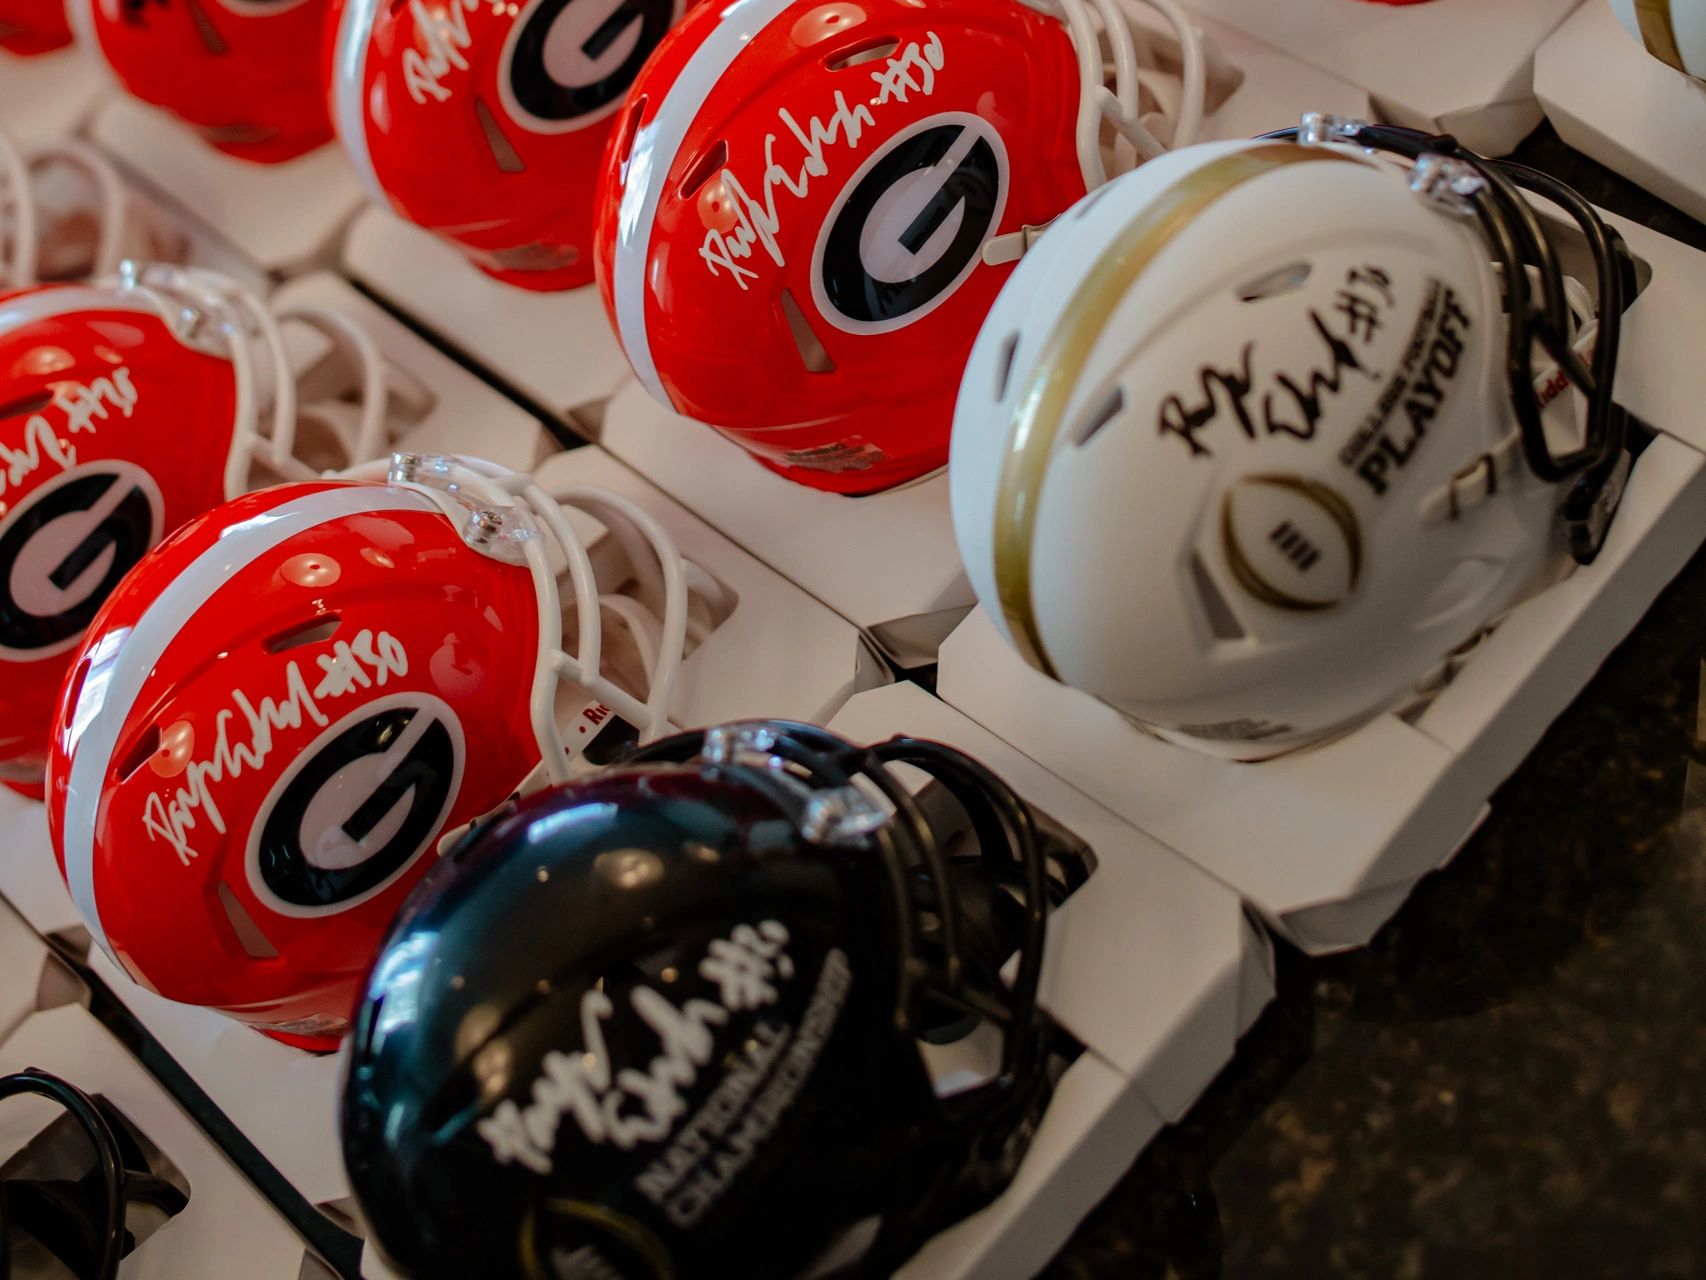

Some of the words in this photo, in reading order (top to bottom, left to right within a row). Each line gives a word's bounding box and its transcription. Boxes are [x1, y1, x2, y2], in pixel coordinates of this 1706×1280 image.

[870, 30, 945, 103] #30
[1355, 287, 1471, 497] PLAYOFF
[634, 1020, 791, 1206] NATIONAL
